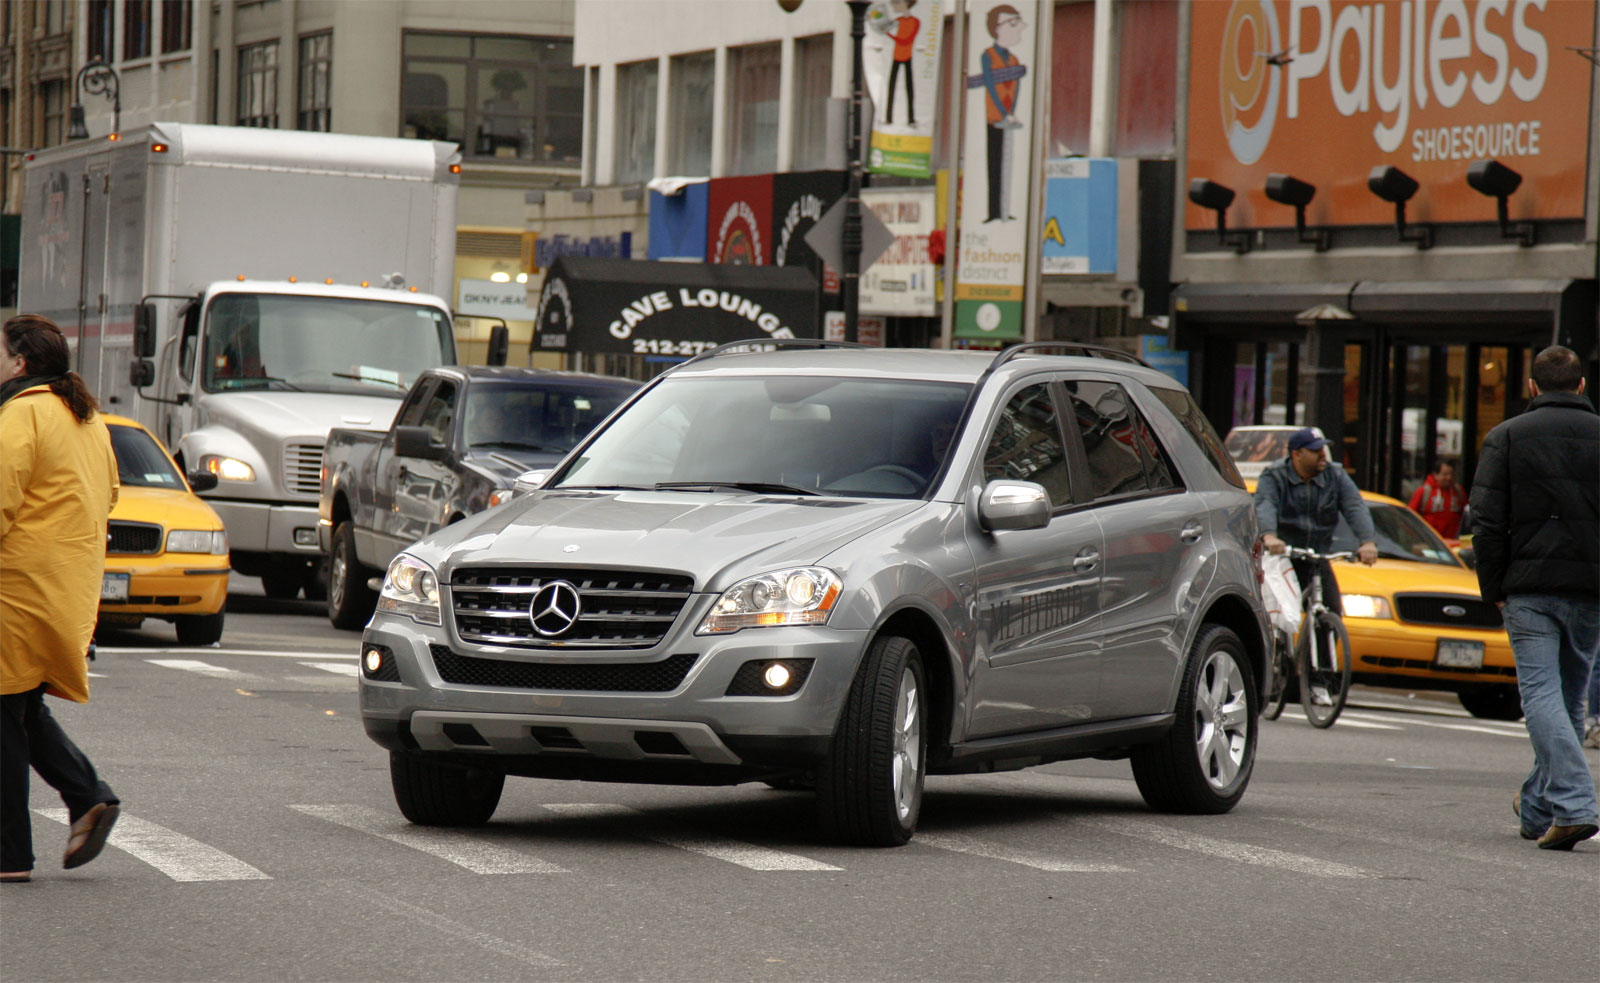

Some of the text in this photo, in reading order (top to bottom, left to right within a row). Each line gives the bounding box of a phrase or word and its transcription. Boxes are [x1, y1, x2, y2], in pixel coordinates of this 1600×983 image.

[1287, 0, 1549, 153] Payless
[1412, 120, 1541, 162] SHOESOURCE
[965, 231, 989, 247] the
[964, 248, 1022, 264] fashion
[962, 264, 1009, 280] district
[464, 293, 498, 304] DKNY
[609, 287, 796, 341] CAVE LOUNGE
[1021, 585, 1082, 635] HYBRID
